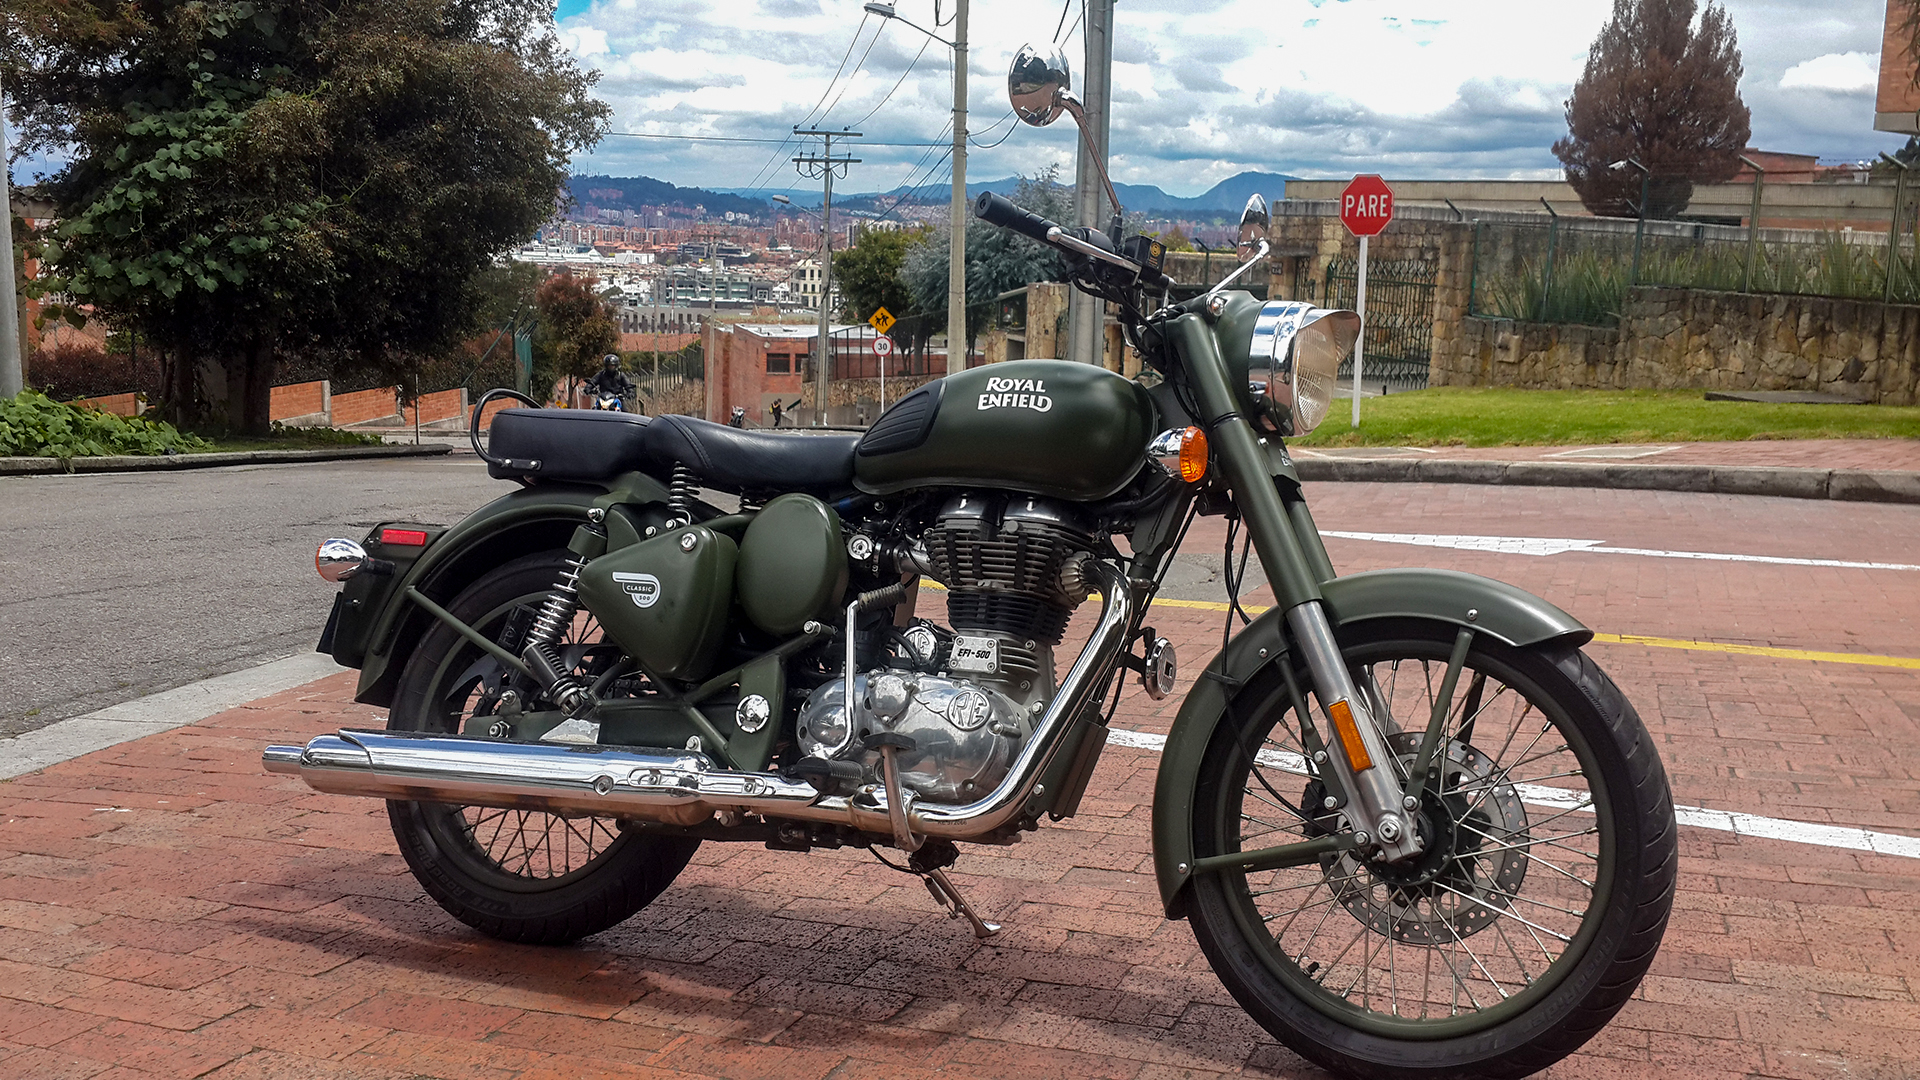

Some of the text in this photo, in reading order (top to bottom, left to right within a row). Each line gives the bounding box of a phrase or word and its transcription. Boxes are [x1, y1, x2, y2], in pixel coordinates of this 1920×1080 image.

[1345, 195, 1388, 217] PARE
[986, 377, 1046, 392] ROYAL
[977, 393, 1053, 412] ENFIELD
[957, 648, 991, 659] EFI-500
[951, 691, 988, 727] RE
